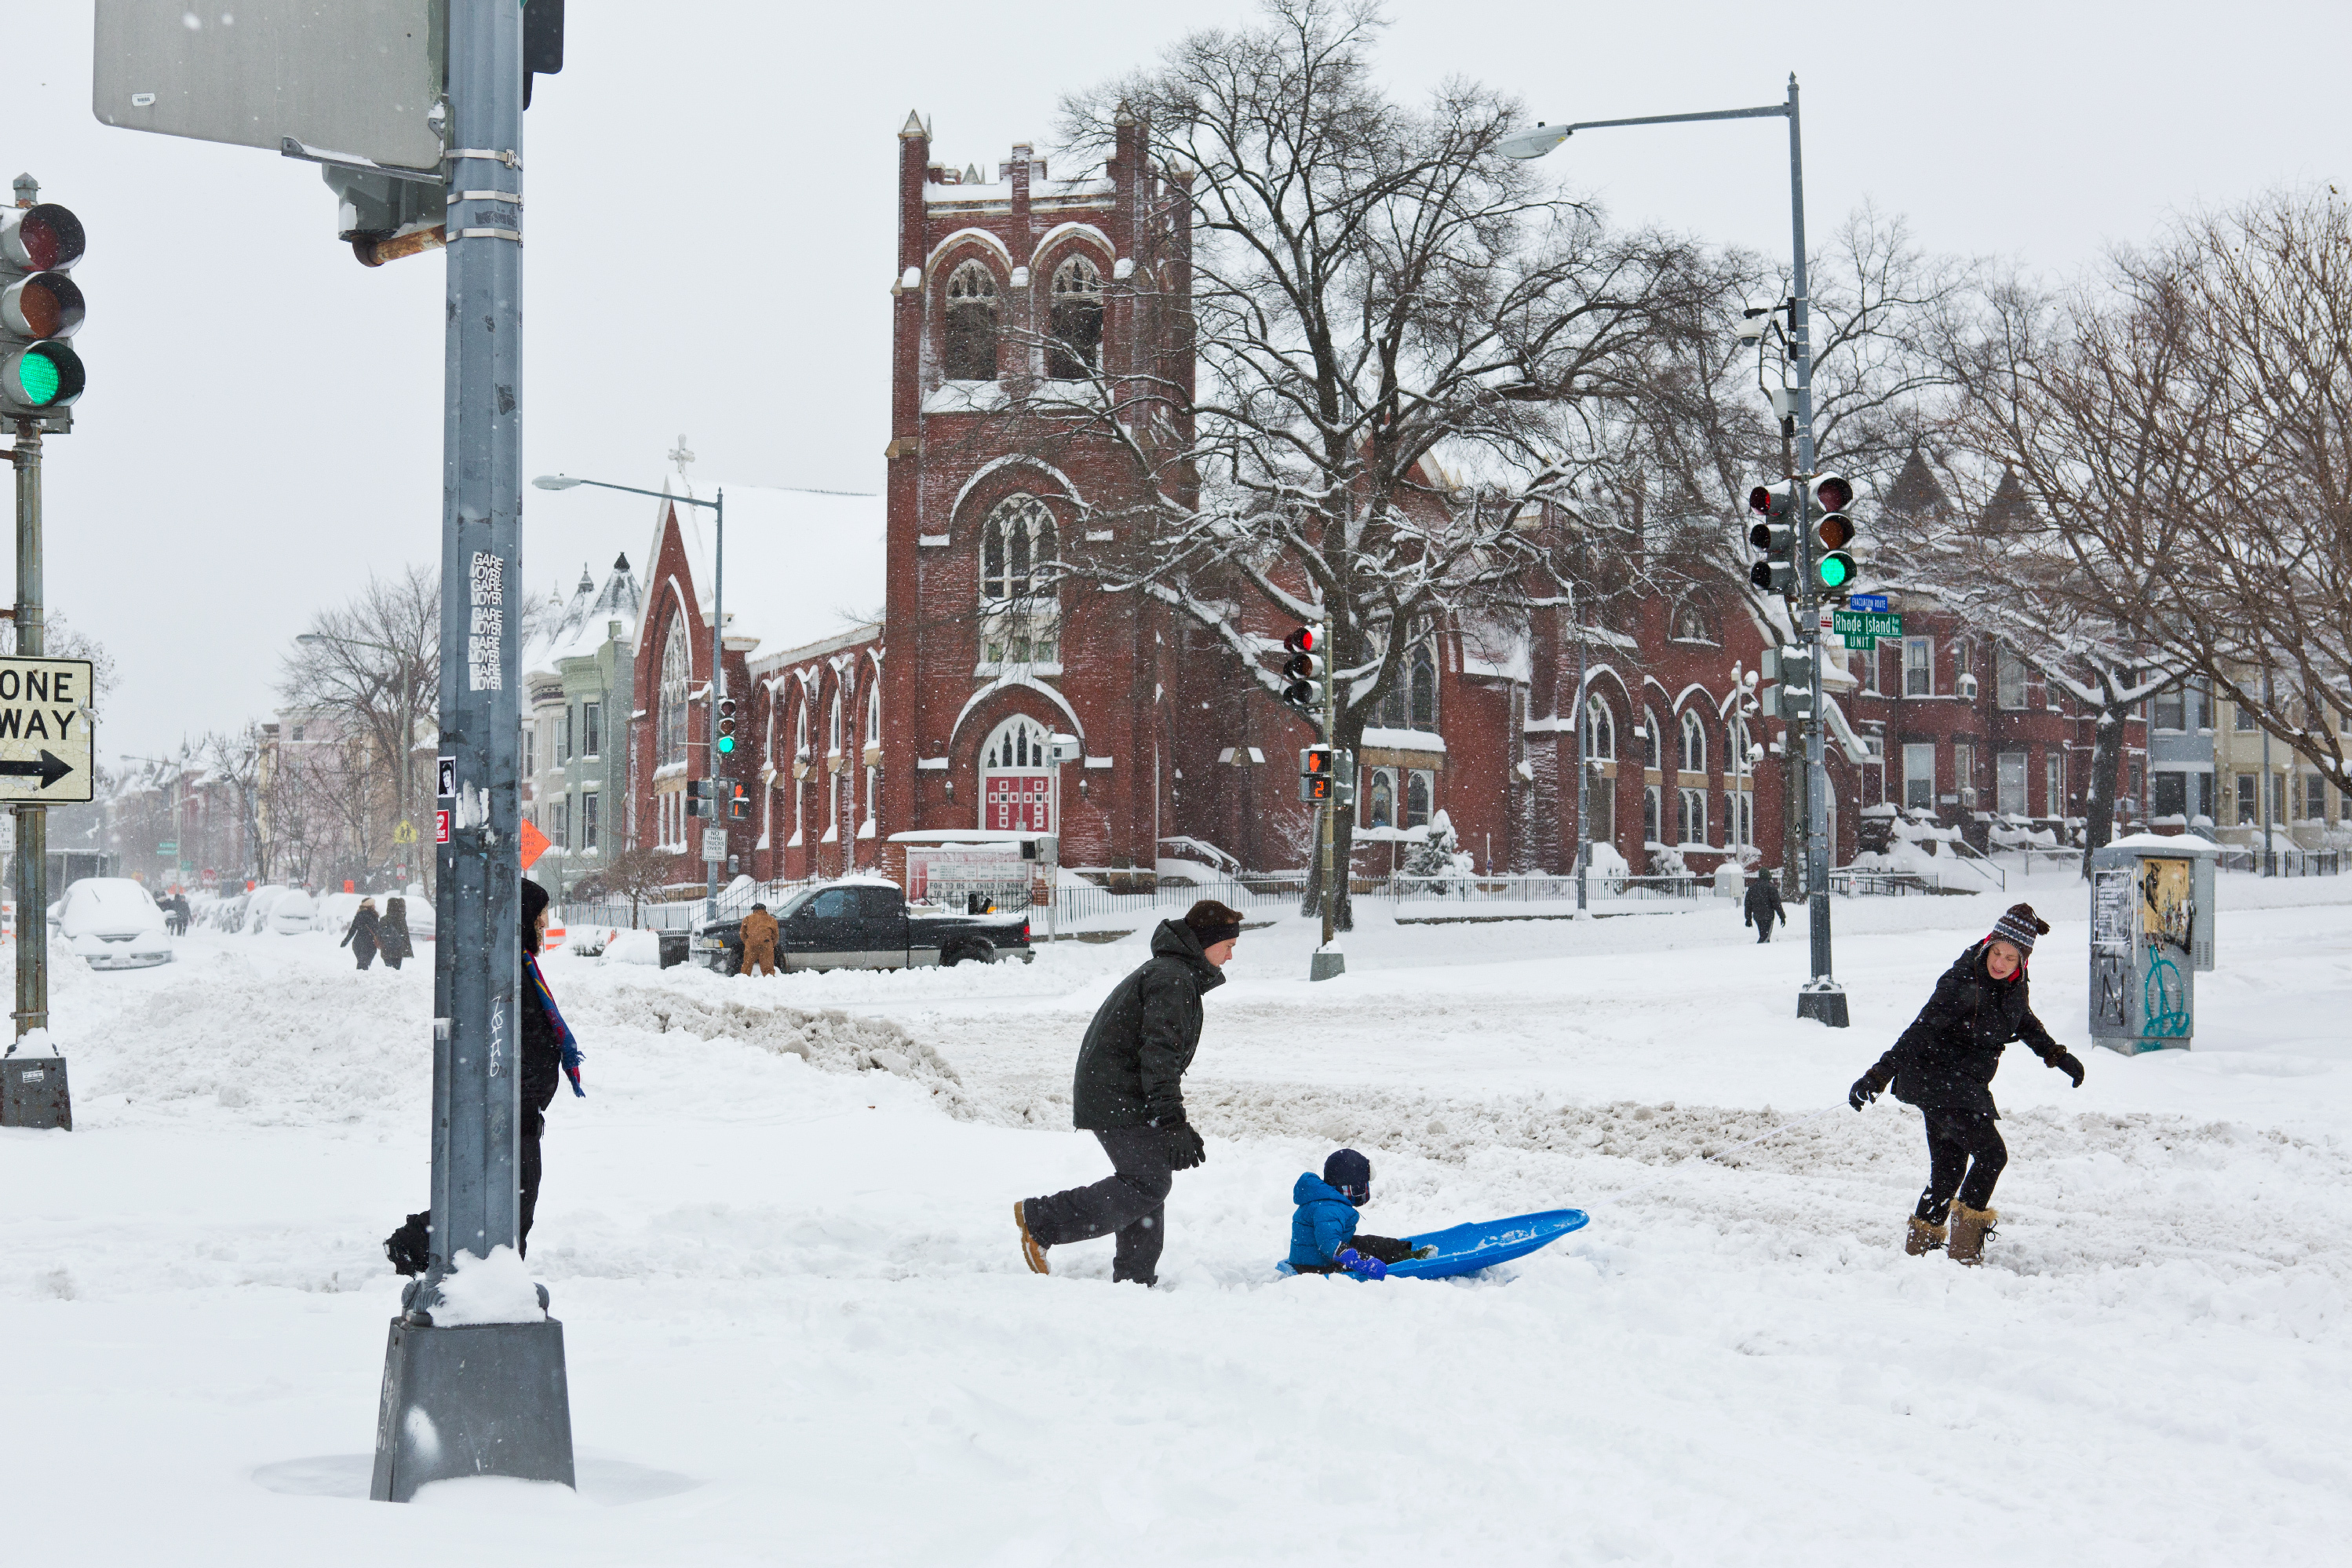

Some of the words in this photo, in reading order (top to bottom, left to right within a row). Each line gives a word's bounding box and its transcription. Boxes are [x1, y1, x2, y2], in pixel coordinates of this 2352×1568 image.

[1851, 597, 1874, 607] EVACUATION
[1875, 599, 1886, 609] ROUTE
[1835, 614, 1862, 632] Rhode
[1865, 615, 1891, 633] Island
[1850, 636, 1869, 648] UNIT
[0, 669, 74, 702] ONE
[0, 709, 76, 740] WAY
[1315, 781, 1324, 797] 2
